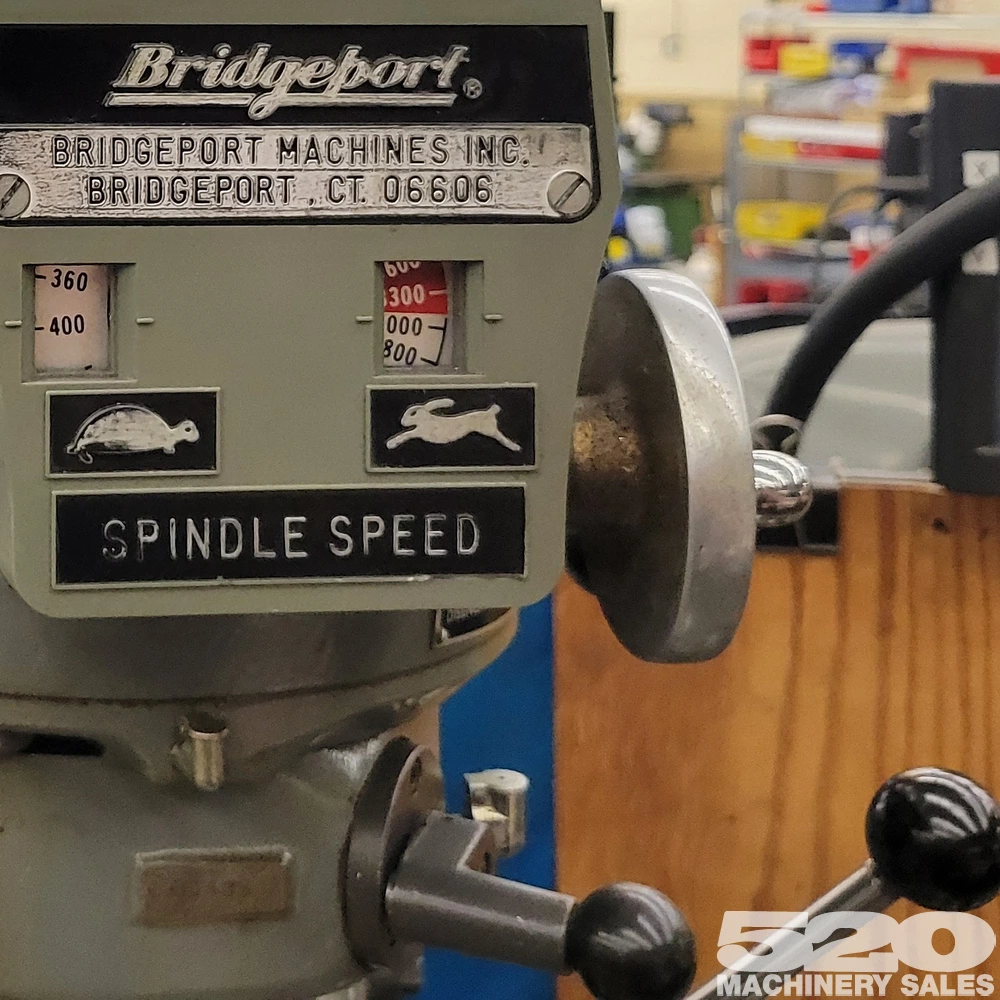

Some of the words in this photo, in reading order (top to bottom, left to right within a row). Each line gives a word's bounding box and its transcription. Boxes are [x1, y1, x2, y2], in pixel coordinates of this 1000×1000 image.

[110, 42, 470, 121] Bridgeport
[52, 135, 263, 167] BRIDGEPORT
[277, 135, 450, 167] MACHINES
[464, 135, 531, 168] INC.
[383, 174, 494, 205] 06606
[50, 268, 89, 292] 360
[49, 313, 85, 336] 400
[101, 515, 308, 562] SPINDLE
[328, 513, 481, 558] SPEED
